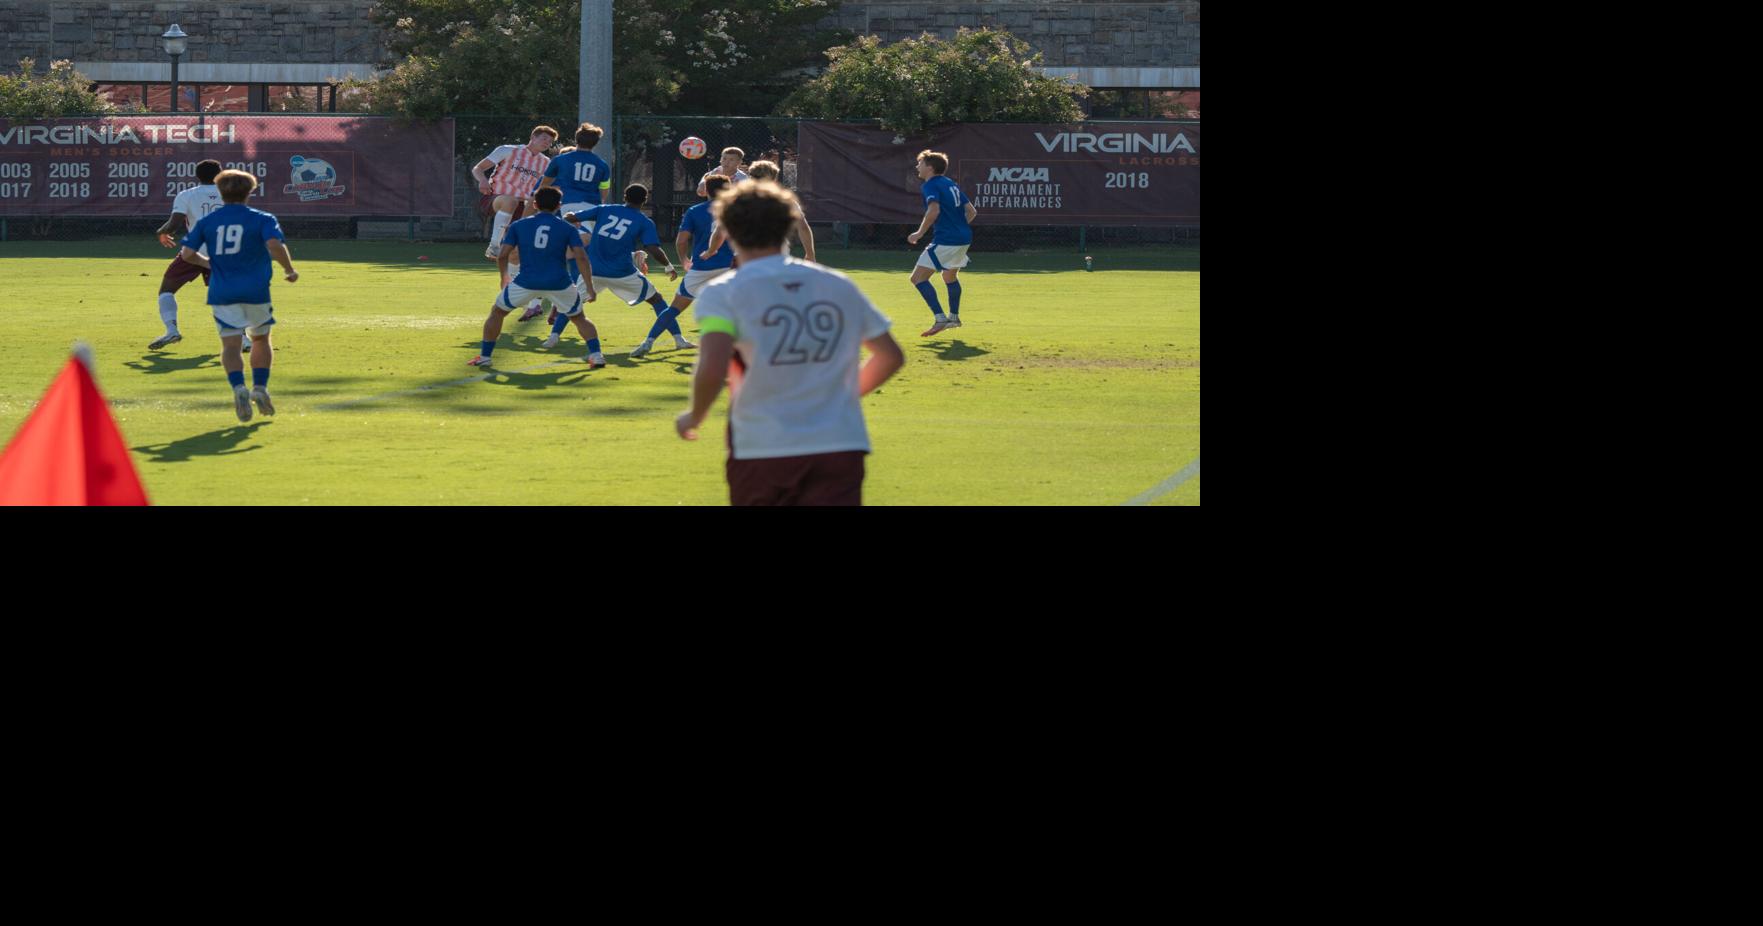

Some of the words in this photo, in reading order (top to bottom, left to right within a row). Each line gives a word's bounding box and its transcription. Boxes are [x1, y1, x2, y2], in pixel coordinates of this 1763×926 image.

[0, 125, 141, 145] VIRGINIA
[144, 124, 235, 144] TECH
[1033, 132, 1197, 153] VIRGINIA
[50, 147, 100, 156] MEN'S
[109, 147, 175, 156] SOCCER
[49, 162, 91, 178] 2005
[108, 162, 149, 178] 2006
[166, 162, 197, 178] 200
[573, 162, 596, 182] 10
[988, 167, 1050, 182] NCAA
[975, 183, 1061, 196] TOURNAMENT
[1105, 172, 1149, 189] 2018
[49, 182, 90, 198] 2018
[107, 182, 149, 198] 2019
[973, 196, 1062, 208] APPEARANCES
[598, 214, 632, 240] 25
[215, 224, 244, 255] 19
[533, 225, 550, 249] 6
[761, 301, 844, 367] 29
